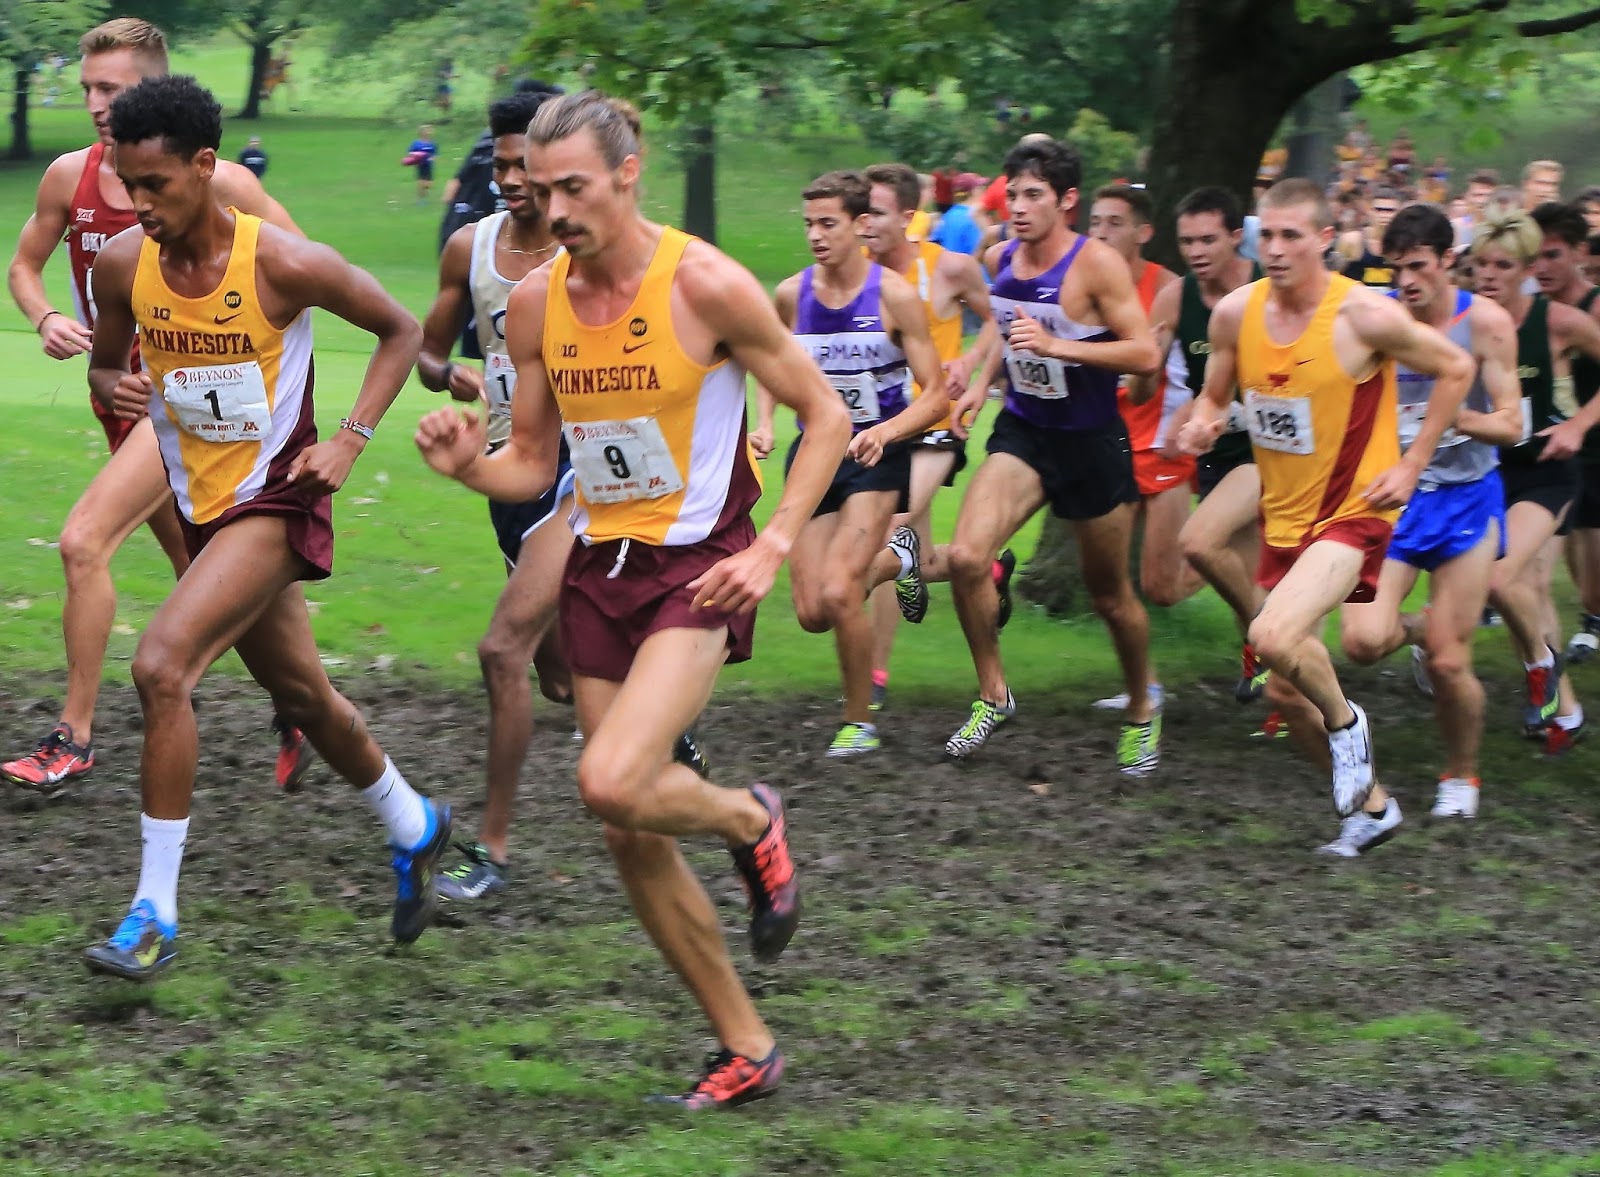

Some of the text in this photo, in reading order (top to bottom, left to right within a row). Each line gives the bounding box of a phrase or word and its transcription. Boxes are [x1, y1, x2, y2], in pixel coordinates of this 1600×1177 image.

[142, 325, 256, 355] MINNESOTA
[189, 367, 243, 383] BEYNON
[550, 364, 661, 394] MINNESOTA
[204, 389, 223, 421] 1
[604, 445, 631, 479] 9
